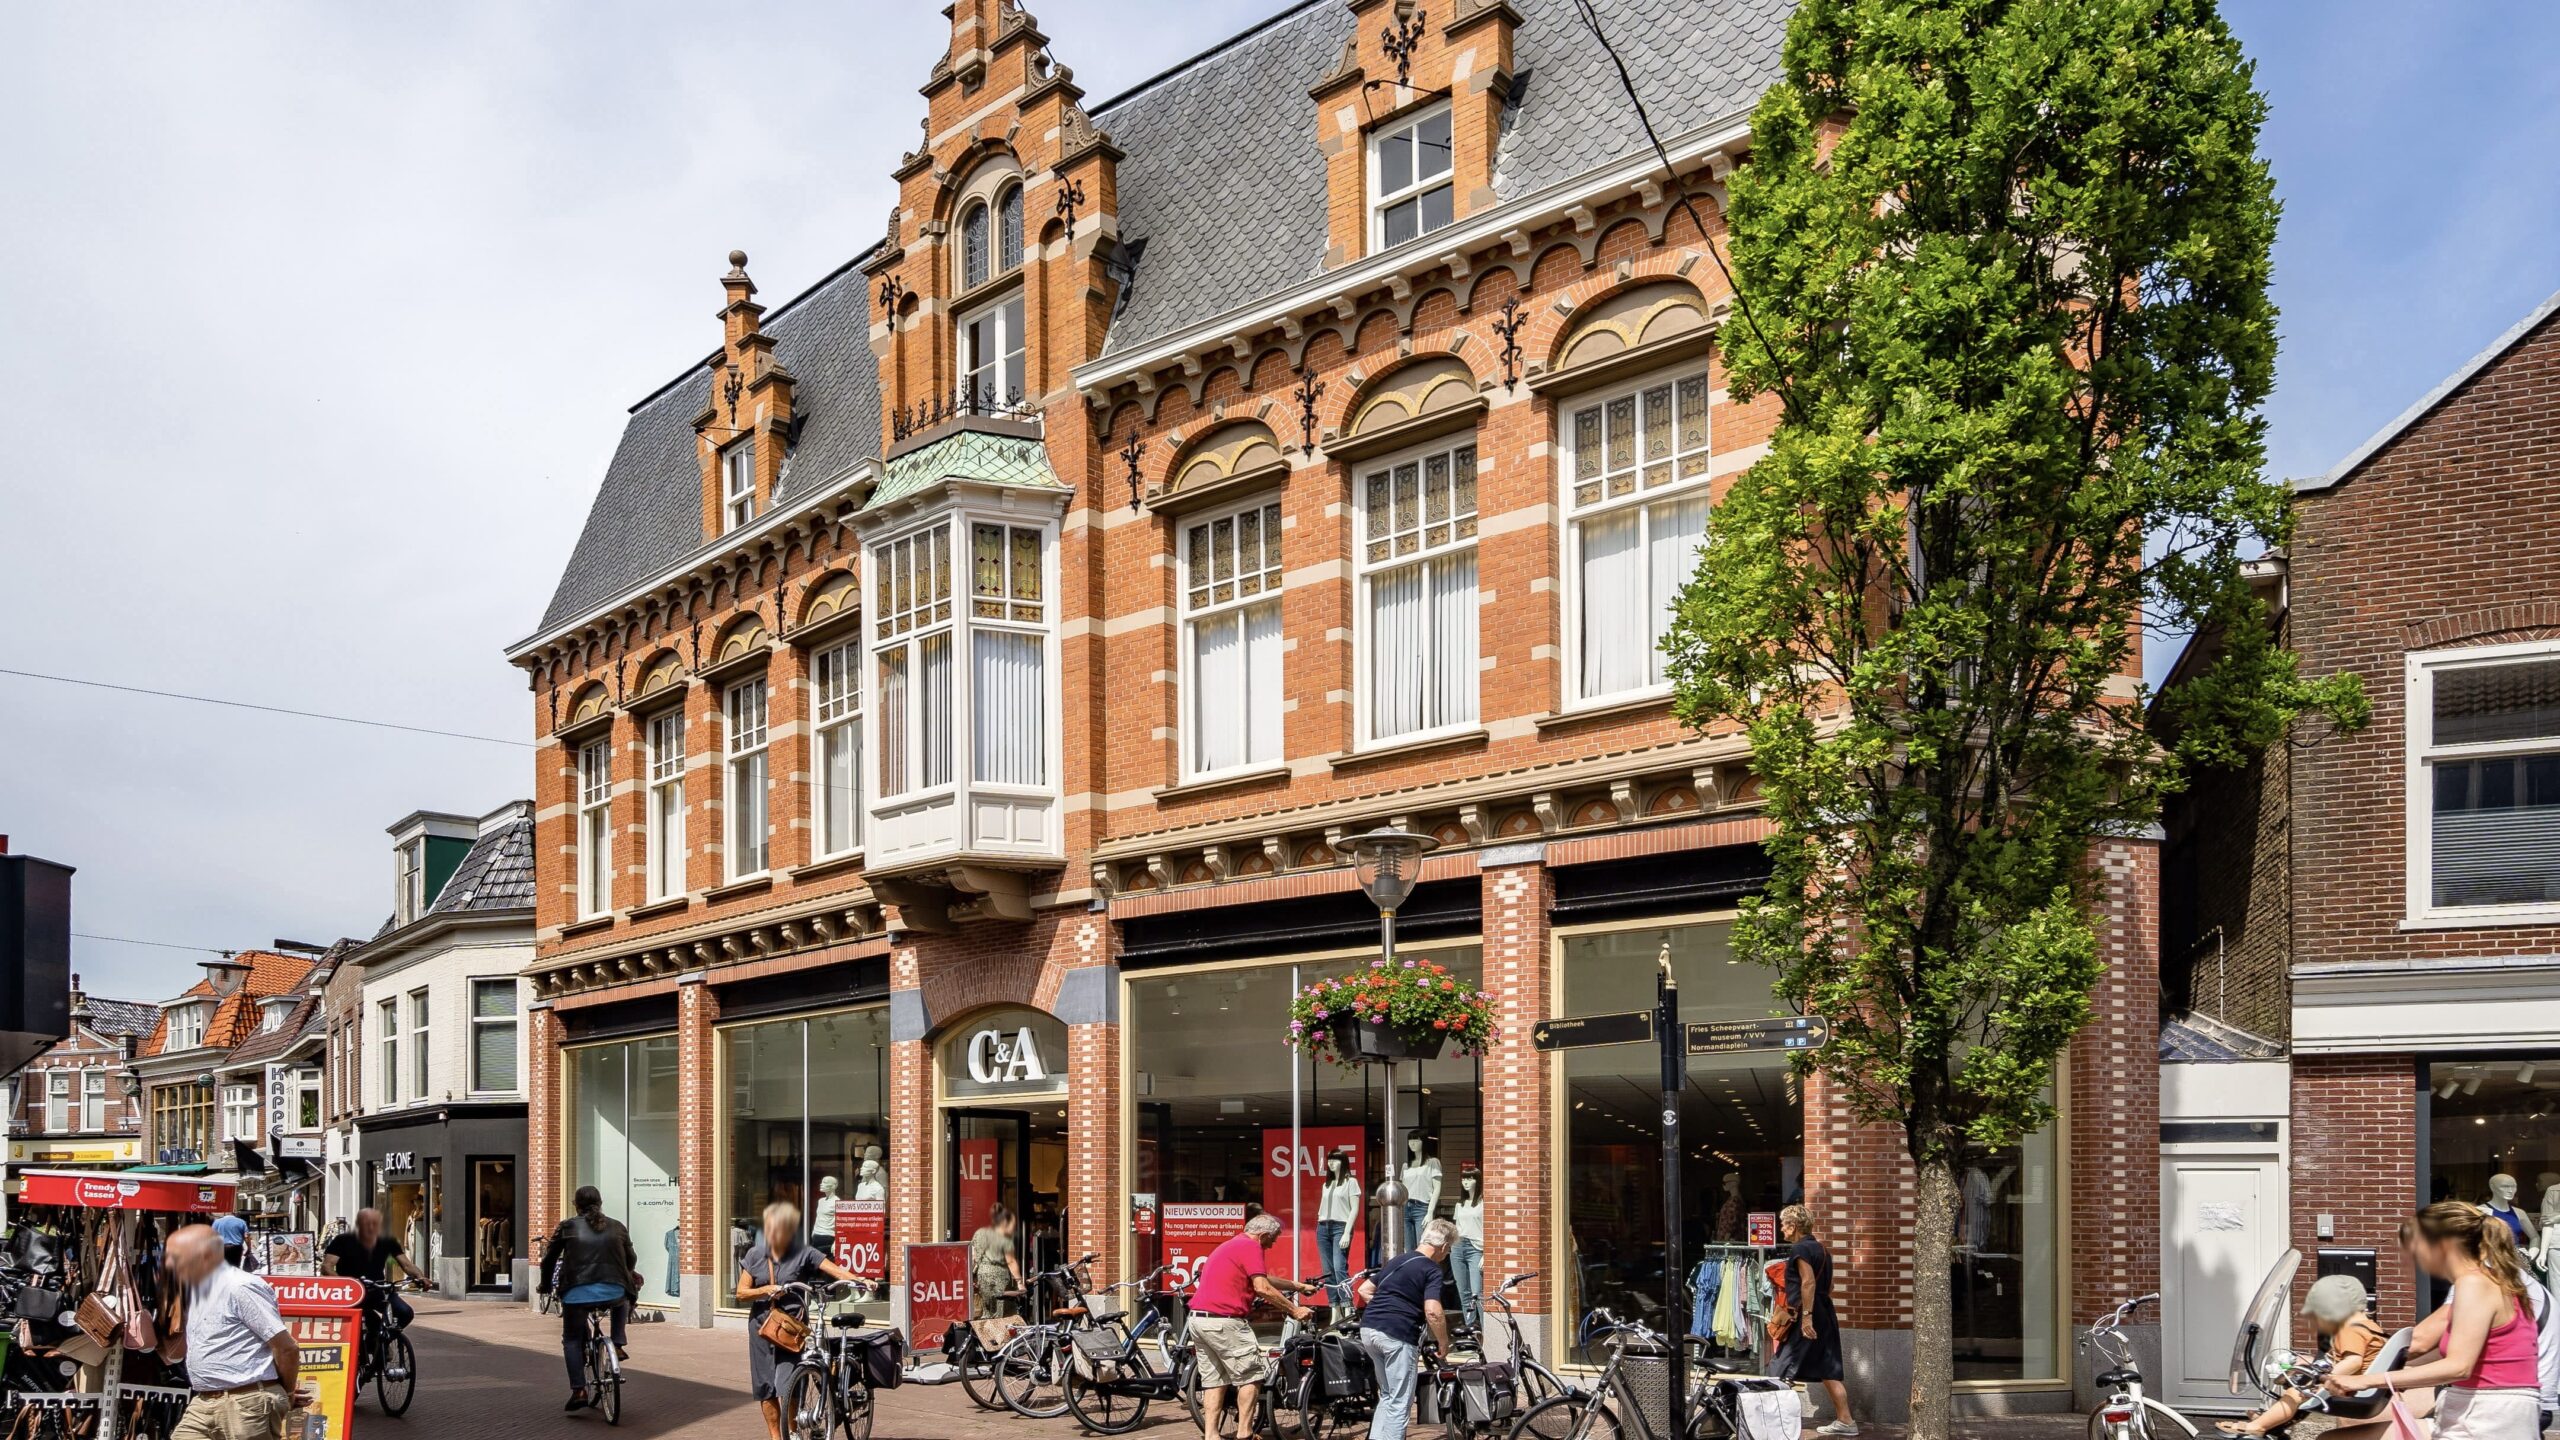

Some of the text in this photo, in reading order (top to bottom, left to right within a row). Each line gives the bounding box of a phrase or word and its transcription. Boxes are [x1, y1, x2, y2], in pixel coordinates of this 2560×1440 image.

[1549, 1020, 1585, 1030] Bibliotheek
[1710, 1023, 1760, 1033] Scheepvaart-
[1690, 1042, 1749, 1051] Normandiaplein
[967, 1026, 1047, 1084] C&A
[385, 1151, 412, 1171] BE ONE
[959, 1153, 993, 1180] ALE
[84, 1182, 116, 1192] Trendy
[84, 1191, 115, 1199] tassen
[836, 1203, 883, 1211] NIEUWS VOOR JOU
[1165, 1207, 1243, 1216] NIEUWS VOOR JOU
[1173, 1223, 1184, 1231] nog
[1219, 1222, 1244, 1230] artikelen
[1165, 1230, 1196, 1238] toegevoegd
[1169, 1247, 1182, 1255] TOT
[839, 1243, 880, 1274] 50%
[266, 1282, 354, 1301] ruidvat
[912, 1279, 965, 1303] SALE
